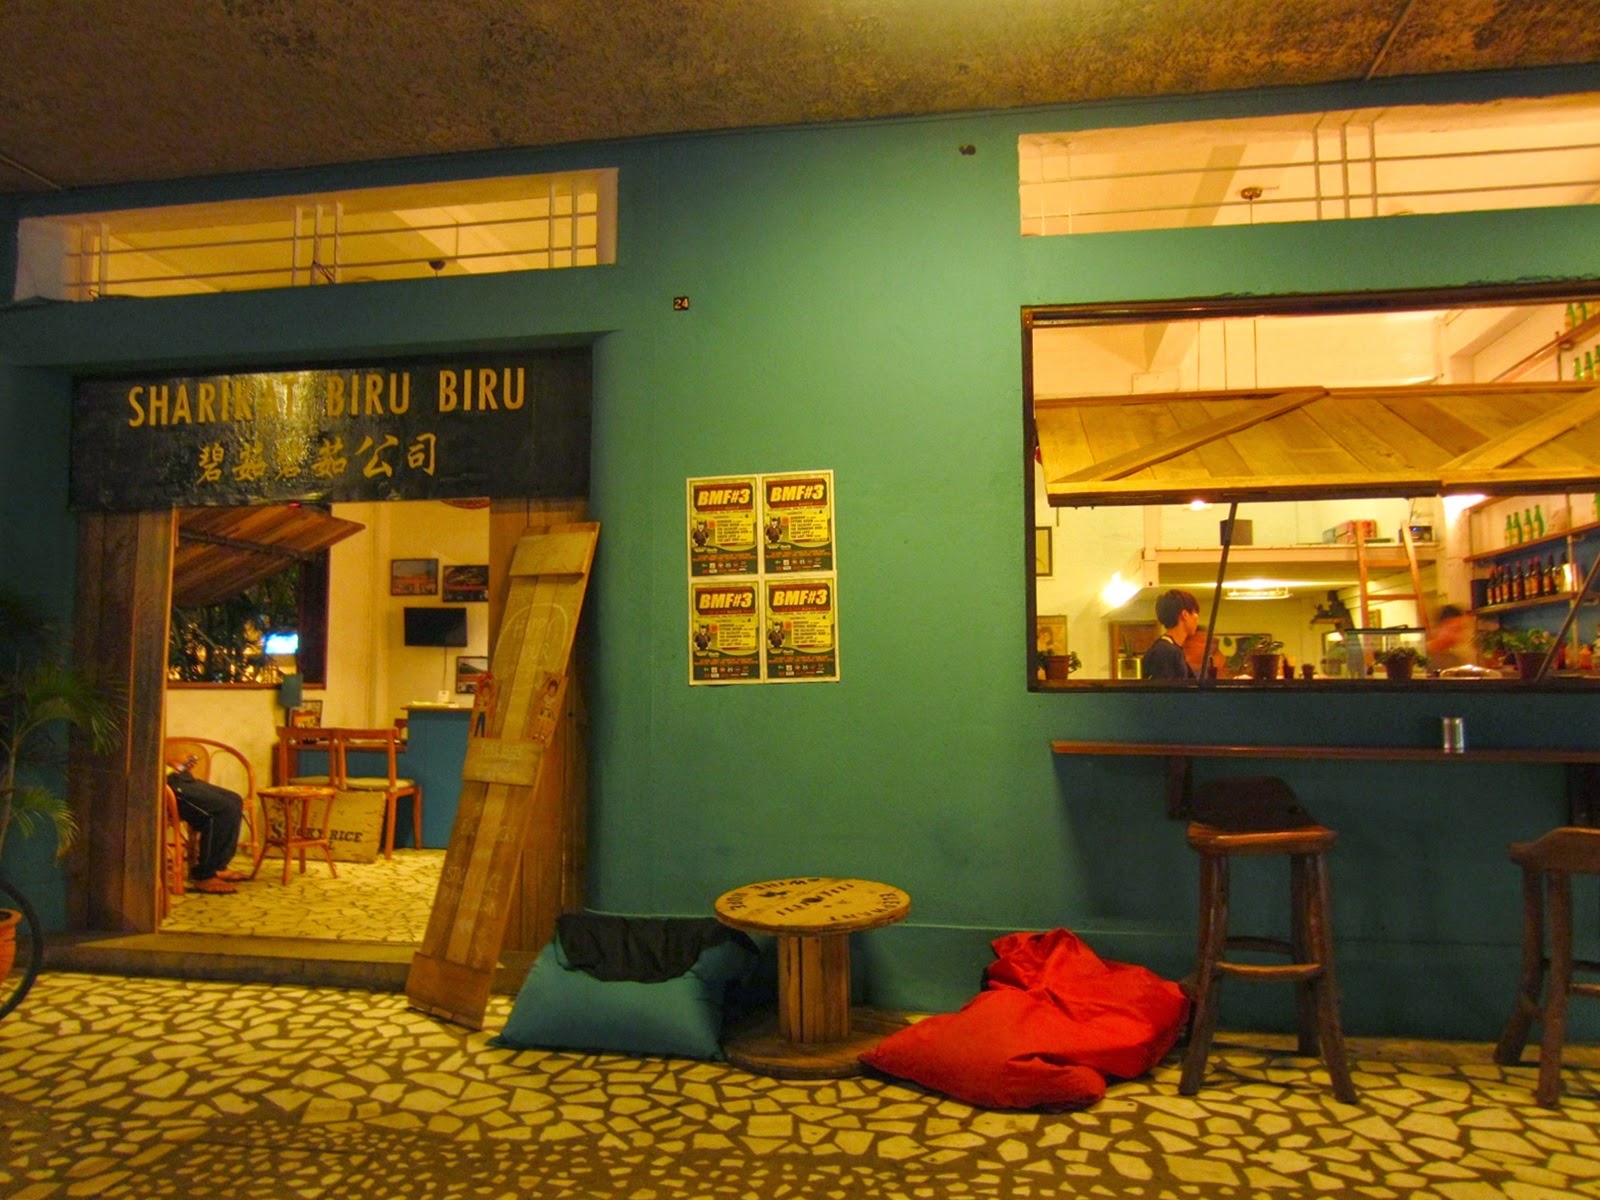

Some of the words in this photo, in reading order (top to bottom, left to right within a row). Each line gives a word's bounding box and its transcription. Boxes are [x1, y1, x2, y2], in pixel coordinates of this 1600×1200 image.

[674, 298, 689, 309] 24
[128, 378, 299, 427] SHARIKAT
[327, 372, 410, 417] BIRU
[439, 367, 525, 412] BIRU
[697, 488, 751, 506] BMF#3
[770, 484, 825, 502] BMF#3
[699, 592, 753, 609] BMF#3
[772, 589, 828, 606] BMF#3
[330, 829, 363, 843] RICE
